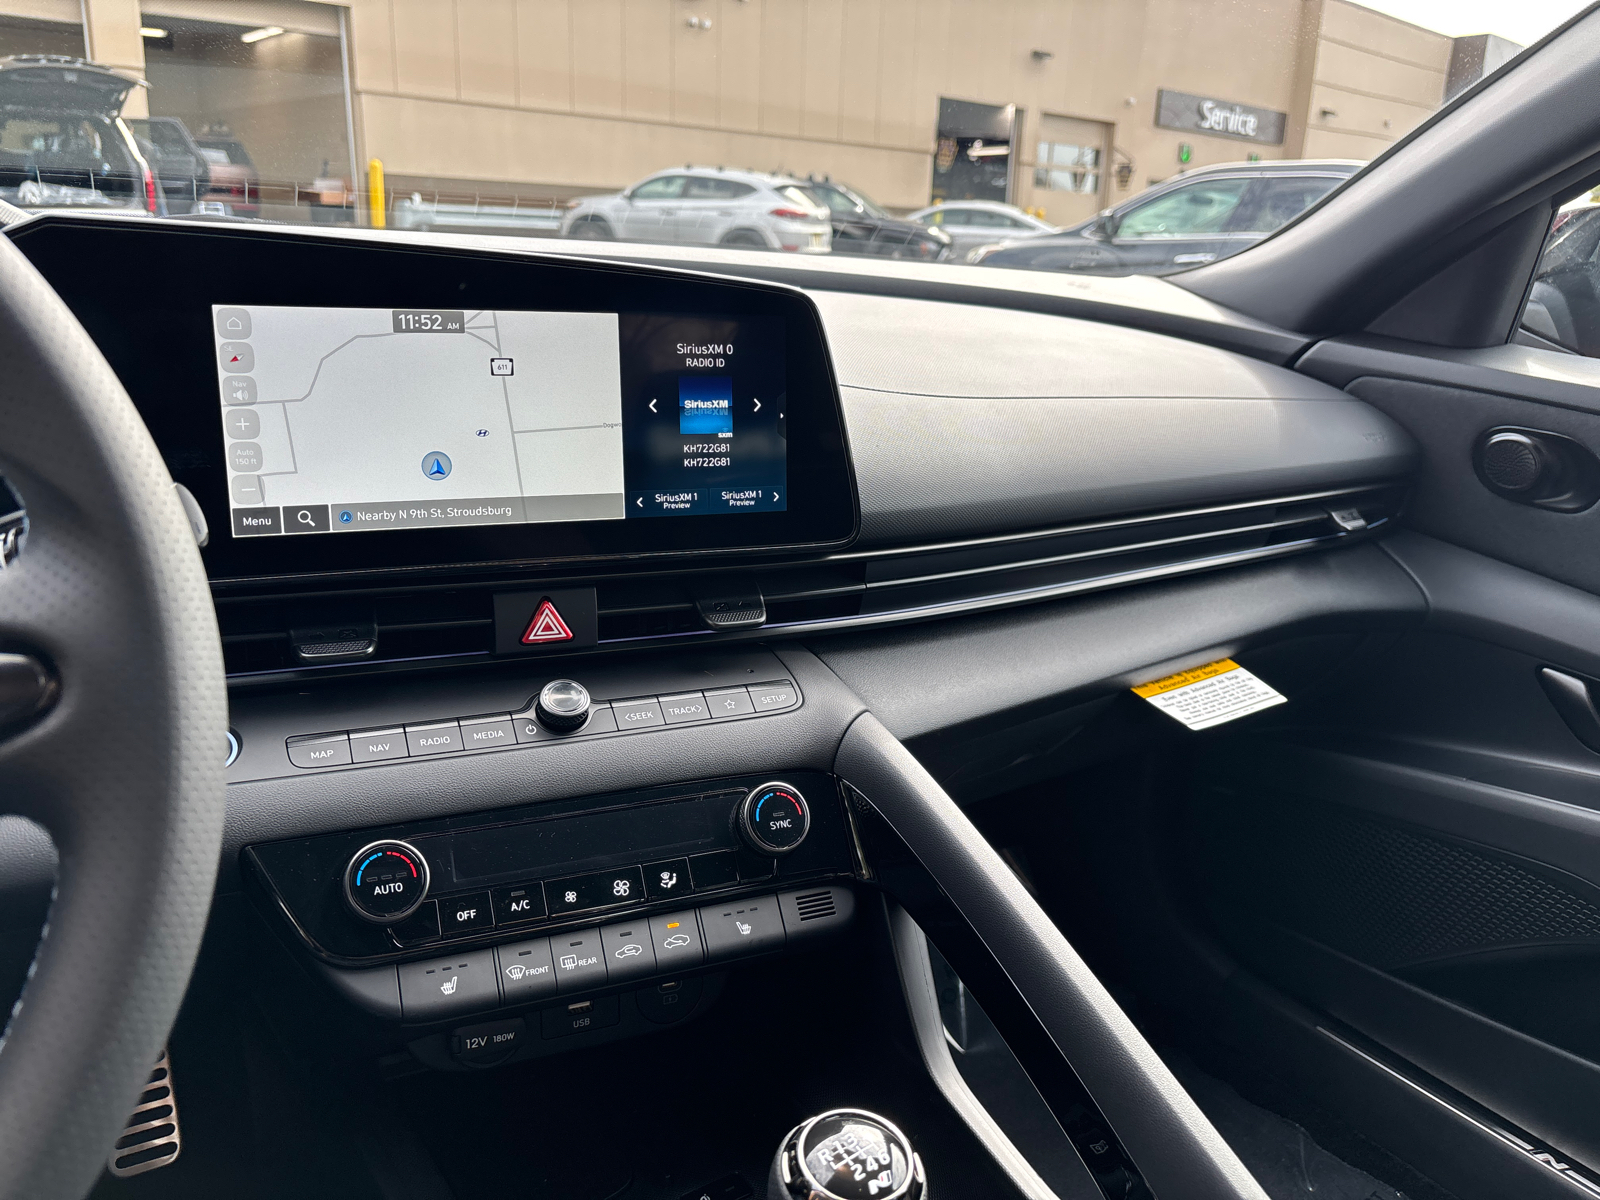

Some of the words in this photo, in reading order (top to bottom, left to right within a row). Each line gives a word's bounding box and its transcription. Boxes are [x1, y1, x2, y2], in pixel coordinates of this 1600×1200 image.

[1199, 100, 1258, 137] Service
[398, 314, 443, 330] 11:52
[446, 322, 460, 330] AM
[676, 343, 724, 355] SiriusXM
[726, 344, 734, 355] 0
[685, 358, 714, 368] RADIO
[715, 358, 726, 368] ID
[232, 380, 247, 388] Nav
[684, 400, 729, 409] SiriusXM
[236, 448, 254, 456] Auto
[683, 443, 731, 453] KH722G81
[683, 457, 731, 467] KH722G81
[655, 493, 692, 502] SiriusXM
[693, 492, 698, 501] 1
[721, 491, 757, 500] SiriusXM
[758, 490, 762, 499] 1
[663, 502, 691, 510] Preview
[729, 499, 756, 507] Preview
[357, 509, 397, 522] Nearby
[399, 509, 408, 519] N
[409, 508, 428, 519] 9th
[430, 507, 445, 519] St,
[446, 505, 513, 518] Stroudsburg
[242, 517, 272, 526] Menu
[761, 694, 788, 704] SETUP
[473, 729, 505, 741] MEDIA
[419, 735, 451, 748] RADIO
[369, 742, 391, 753] NAV
[310, 749, 335, 760] MAP
[769, 818, 793, 831] SYNC
[373, 882, 404, 896] AUTO
[511, 899, 531, 912] A/C
[456, 909, 478, 922] OFF
[578, 956, 598, 967] REAR
[525, 965, 550, 977] FRONT
[573, 1017, 591, 1029] USB
[465, 1035, 488, 1049] 12V
[492, 1031, 515, 1043] 180W
[817, 1148, 834, 1166] R
[832, 1140, 845, 1155] 1
[850, 1163, 867, 1181] 2
[866, 1155, 879, 1172] 4
